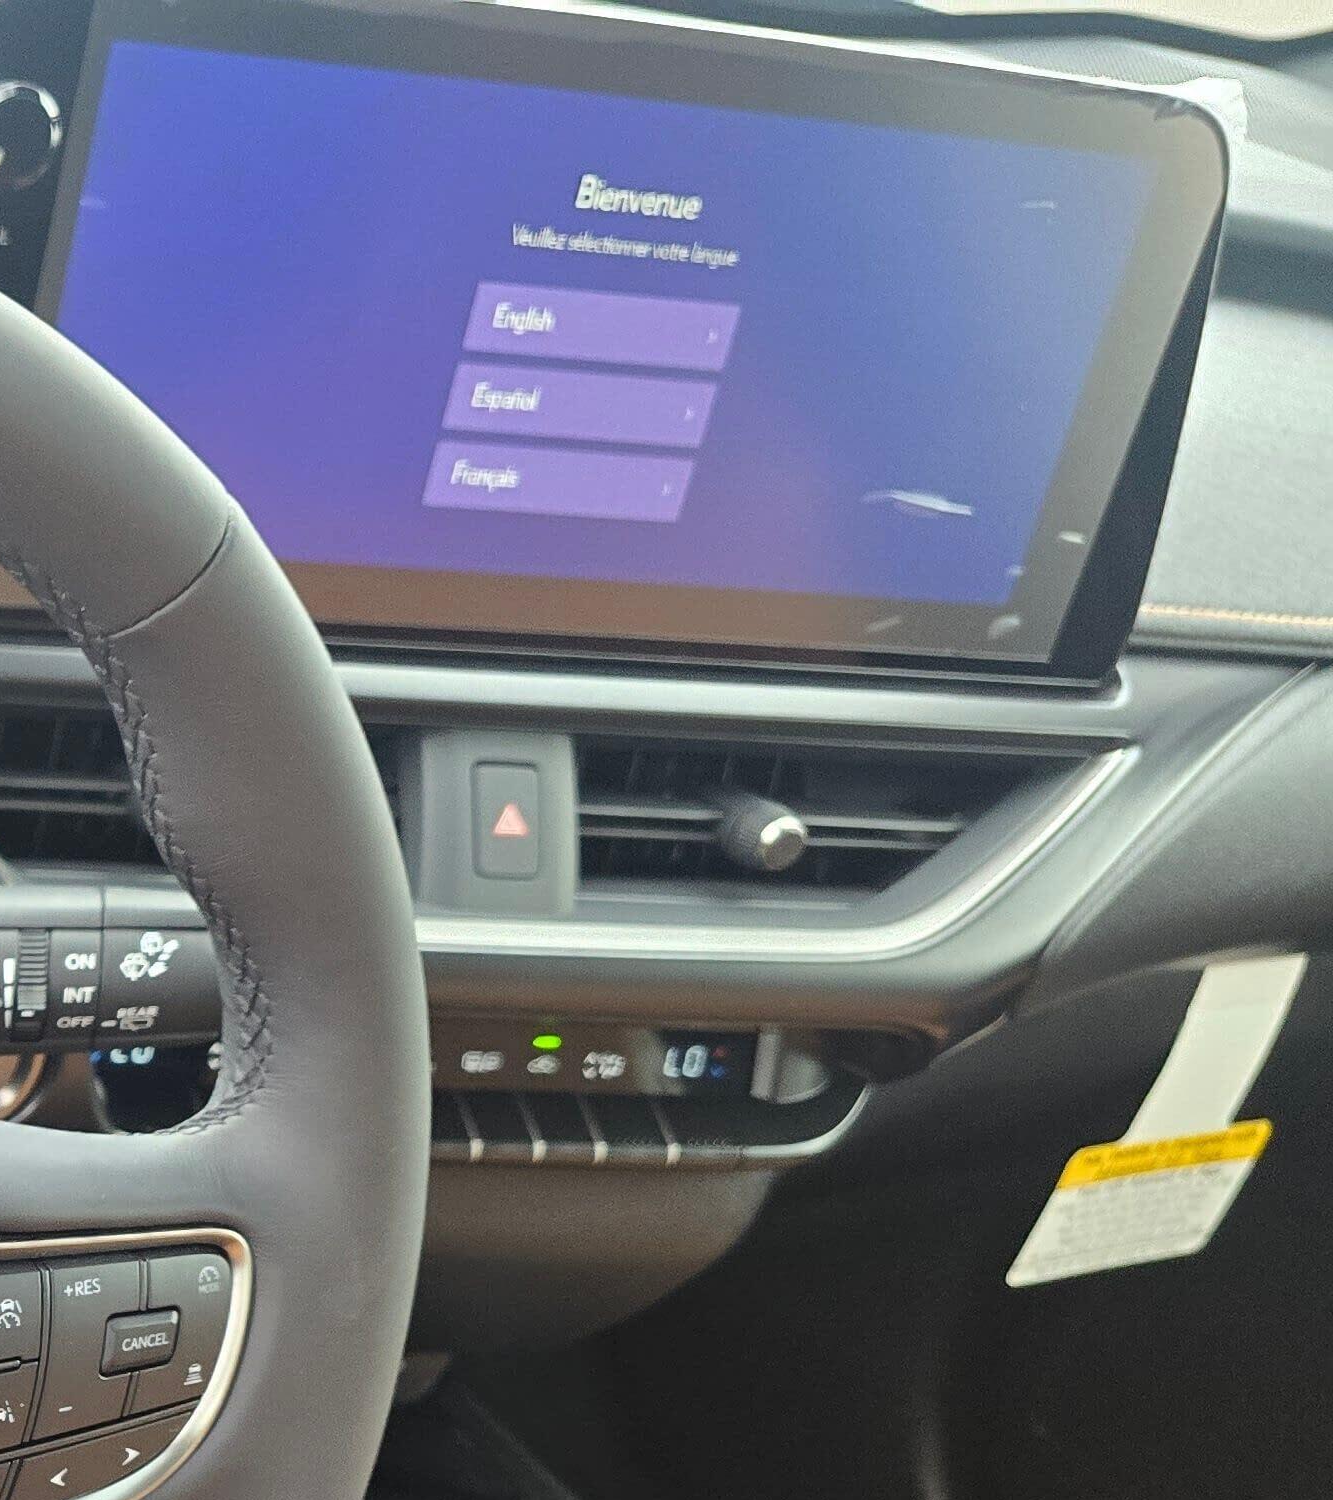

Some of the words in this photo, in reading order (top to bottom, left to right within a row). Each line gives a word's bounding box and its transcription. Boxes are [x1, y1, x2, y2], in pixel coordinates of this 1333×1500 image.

[575, 172, 703, 220] Bienvenue
[492, 302, 555, 335] English
[471, 381, 541, 412] Español
[450, 459, 521, 492] Français
[64, 953, 97, 971] ON
[62, 986, 98, 1004] INT
[56, 1015, 95, 1029] OFF
[64, 1278, 102, 1297] +RES
[121, 1332, 170, 1352] CANCEL
